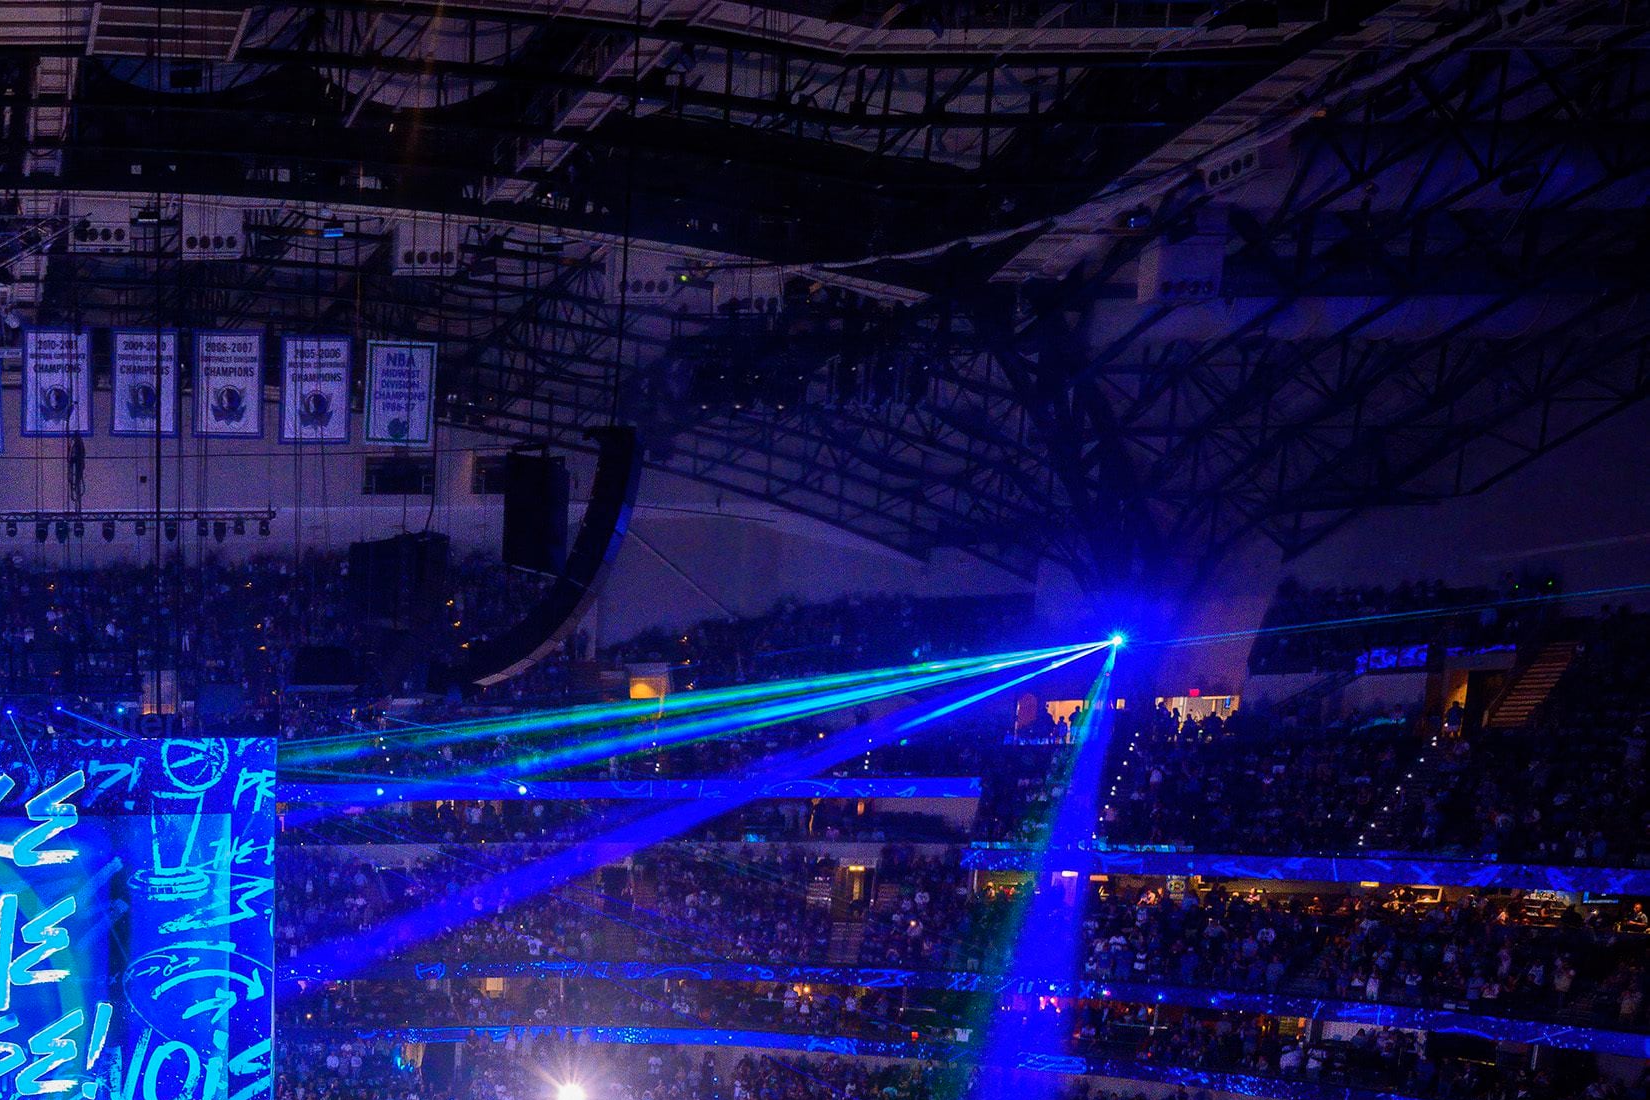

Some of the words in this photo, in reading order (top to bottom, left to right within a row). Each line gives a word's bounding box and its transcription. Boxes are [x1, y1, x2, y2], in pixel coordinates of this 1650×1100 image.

[386, 353, 416, 366] NBA
[33, 364, 81, 374] CHAMPIONS
[204, 366, 255, 377] CHAMPIONS
[292, 373, 342, 383] CHAMPIONS
